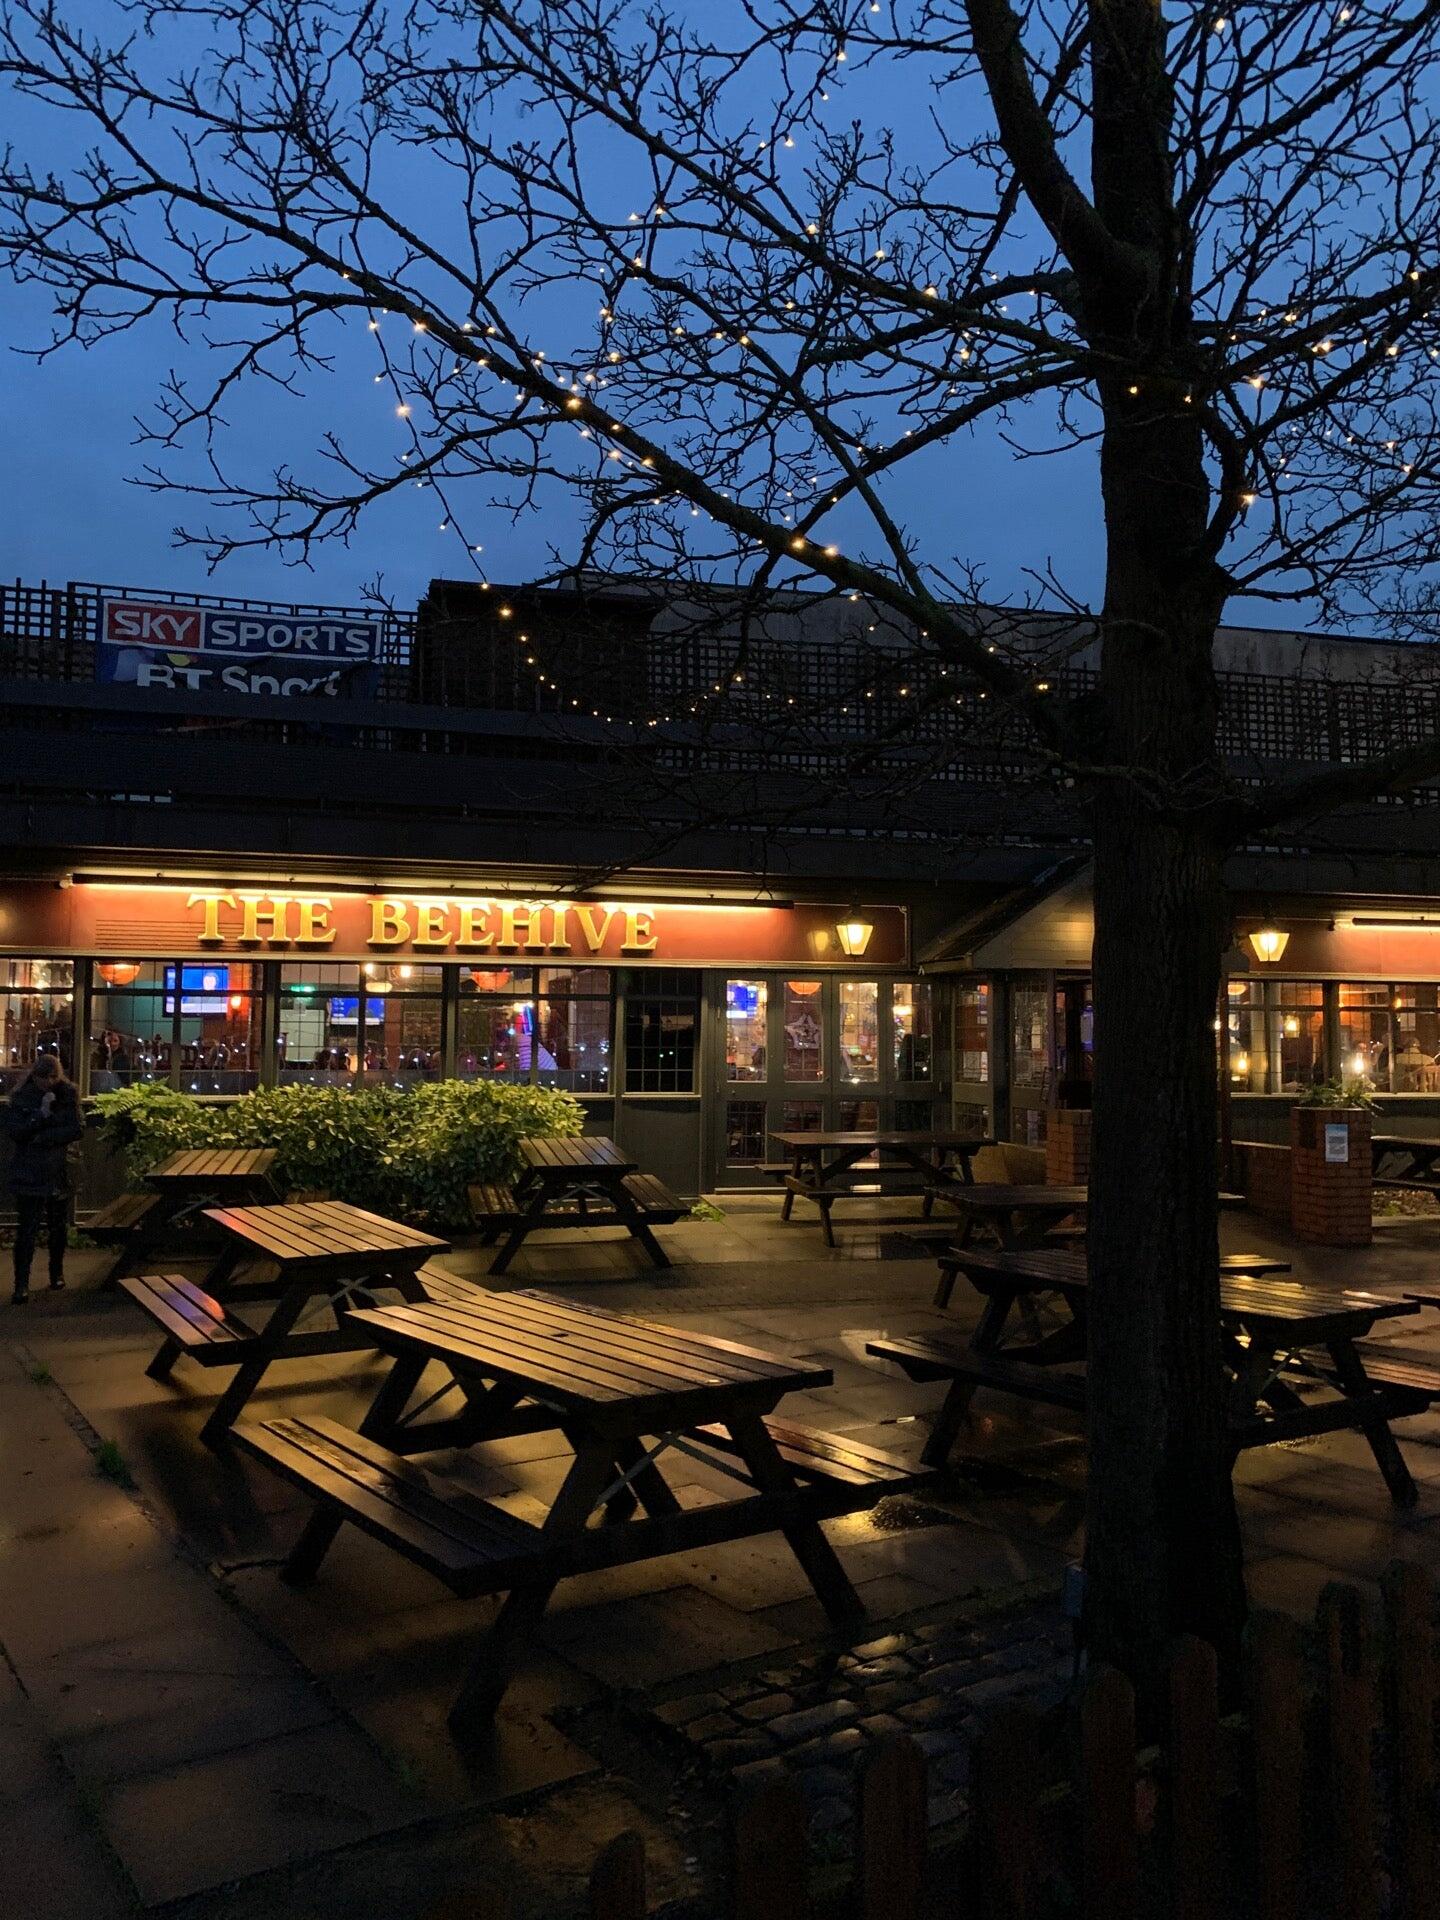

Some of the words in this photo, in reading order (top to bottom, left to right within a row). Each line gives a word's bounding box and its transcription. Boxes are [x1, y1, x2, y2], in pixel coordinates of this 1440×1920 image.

[114, 610, 196, 641] SKY
[211, 620, 370, 653] SPORTS
[186, 893, 337, 943] THE
[366, 899, 658, 951] BEEHIVE
